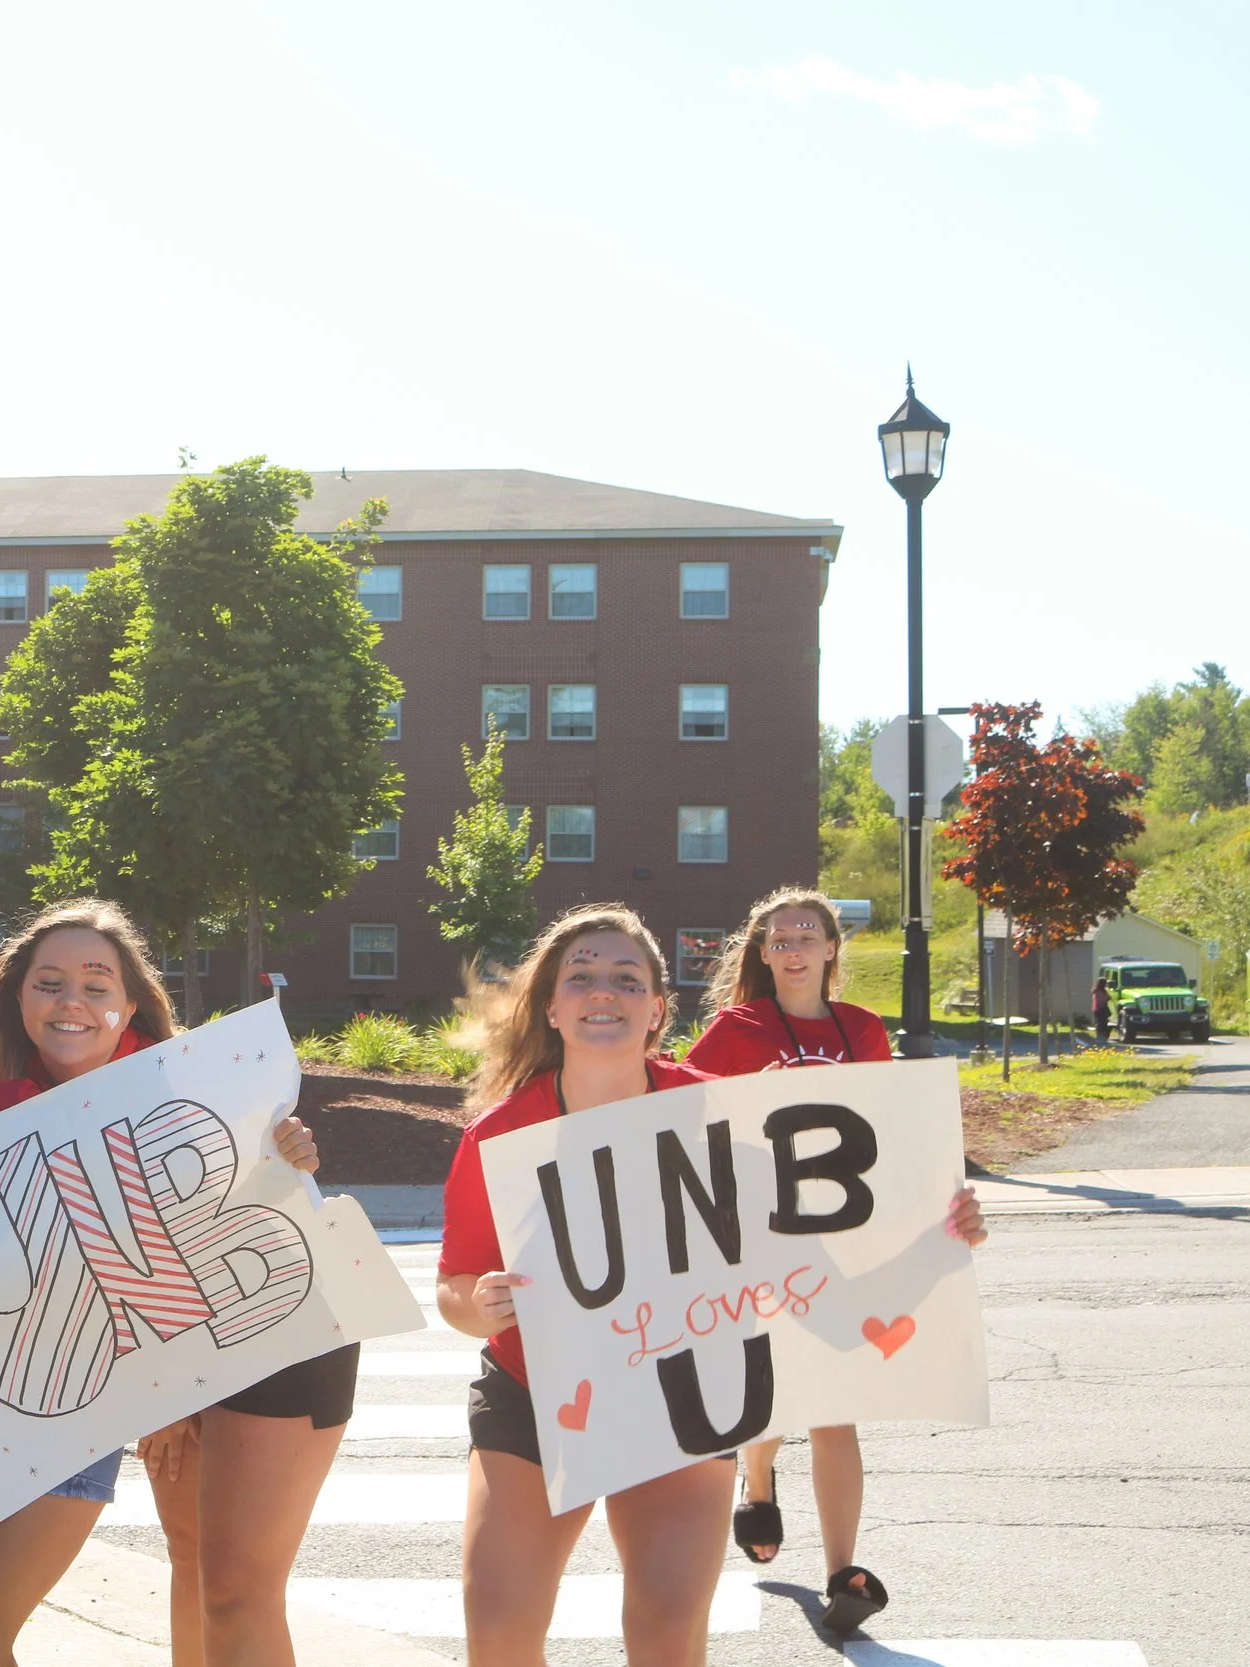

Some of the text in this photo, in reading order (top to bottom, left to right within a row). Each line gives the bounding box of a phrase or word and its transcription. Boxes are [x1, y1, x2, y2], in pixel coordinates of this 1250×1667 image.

[536, 1103, 878, 1310] UNB
[611, 1264, 828, 1367] Loves
[656, 1332, 775, 1457] U
